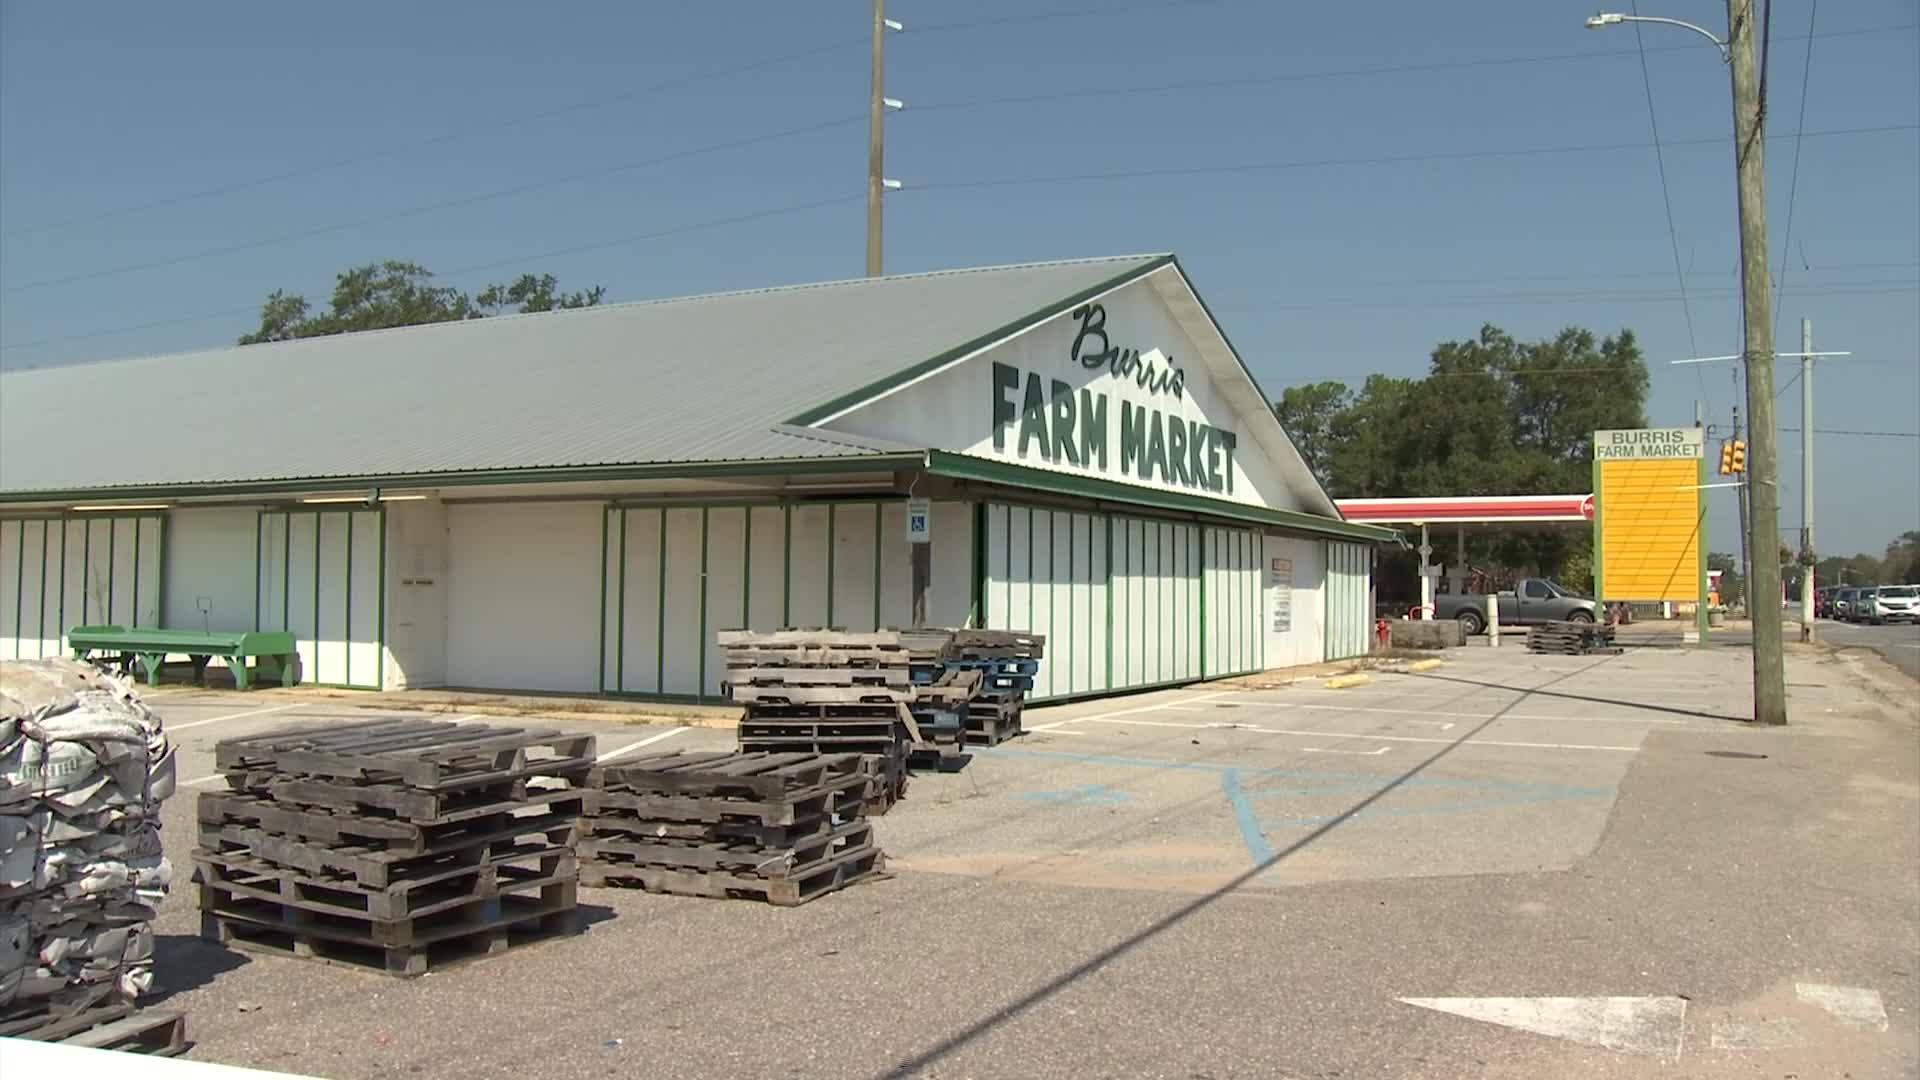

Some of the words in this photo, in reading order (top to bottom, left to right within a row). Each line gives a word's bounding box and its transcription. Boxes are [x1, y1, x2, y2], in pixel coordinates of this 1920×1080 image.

[1070, 303, 1185, 400] Burris
[992, 360, 1108, 473] FARM
[1120, 399, 1237, 496] MARKET
[1597, 445, 1635, 458] FARM
[1641, 443, 1701, 457] MARKET
[1612, 430, 1685, 445] BURRIS
